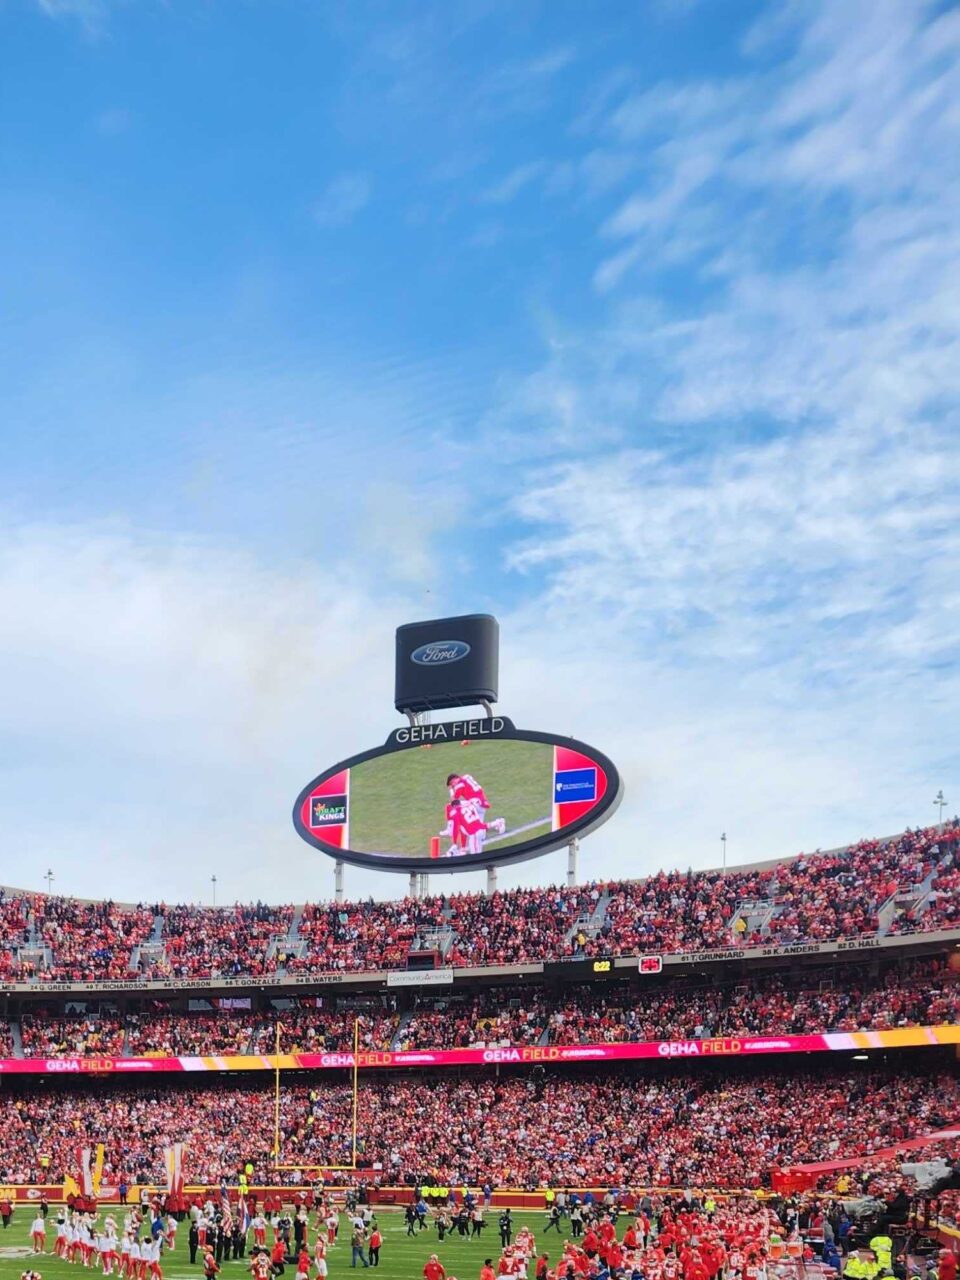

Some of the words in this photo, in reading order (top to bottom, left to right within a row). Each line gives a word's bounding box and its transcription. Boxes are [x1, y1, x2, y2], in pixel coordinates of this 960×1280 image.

[422, 644, 458, 662] Ford
[396, 724, 447, 743] GEHA
[452, 718, 505, 736] FIELD
[319, 812, 345, 820] KINGS
[858, 940, 881, 948] HALL
[784, 945, 820, 954] ANDERS
[699, 952, 744, 960] GRUNHARD
[242, 978, 280, 986] GONZALEZ
[658, 1042, 698, 1056] GEHA
[702, 1041, 741, 1054] FIELD
[484, 1050, 520, 1061] GEHA
[522, 1048, 558, 1060] FIELD
[46, 1060, 79, 1070] GEHA
[81, 1060, 113, 1070] FIELD
[321, 1056, 355, 1066] GEHA
[356, 1054, 391, 1064] FIELD
